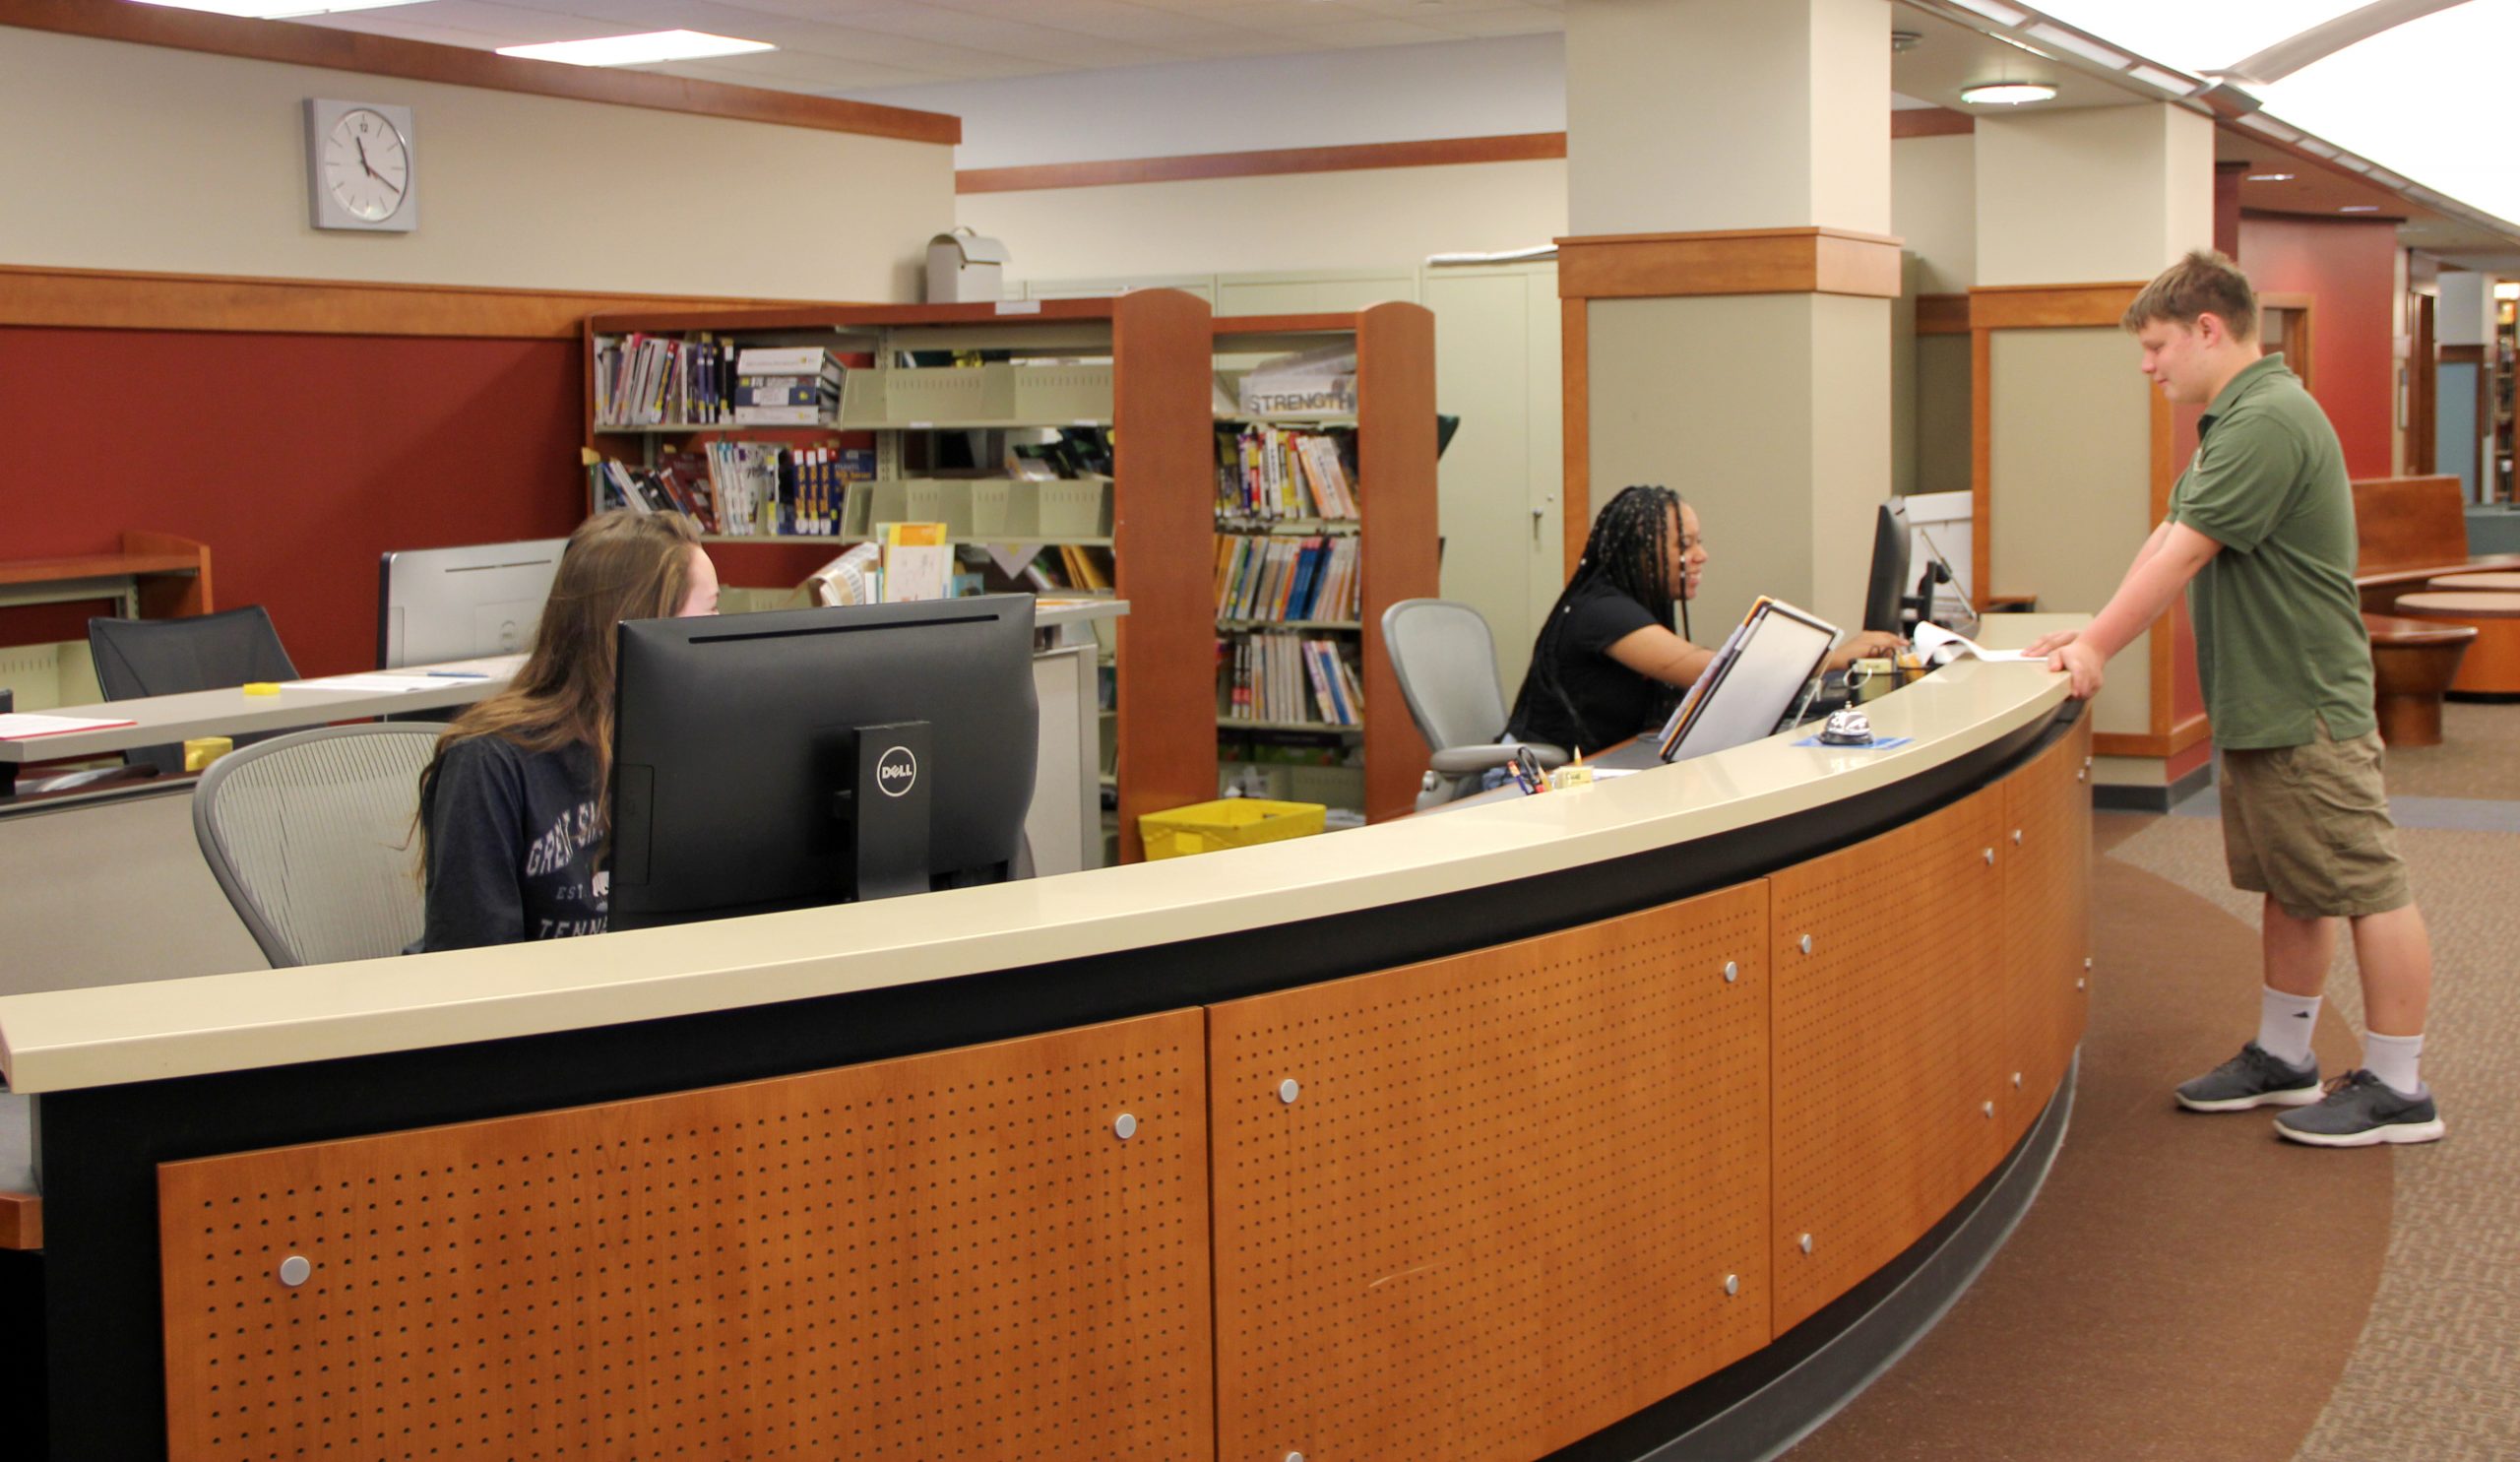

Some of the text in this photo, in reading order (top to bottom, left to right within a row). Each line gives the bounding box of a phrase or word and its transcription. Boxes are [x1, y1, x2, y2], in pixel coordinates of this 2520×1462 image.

[359, 122, 369, 133] 12
[1248, 392, 1353, 414] STRENGTH
[881, 764, 913, 779] DELL
[526, 809, 574, 876] GREAT
